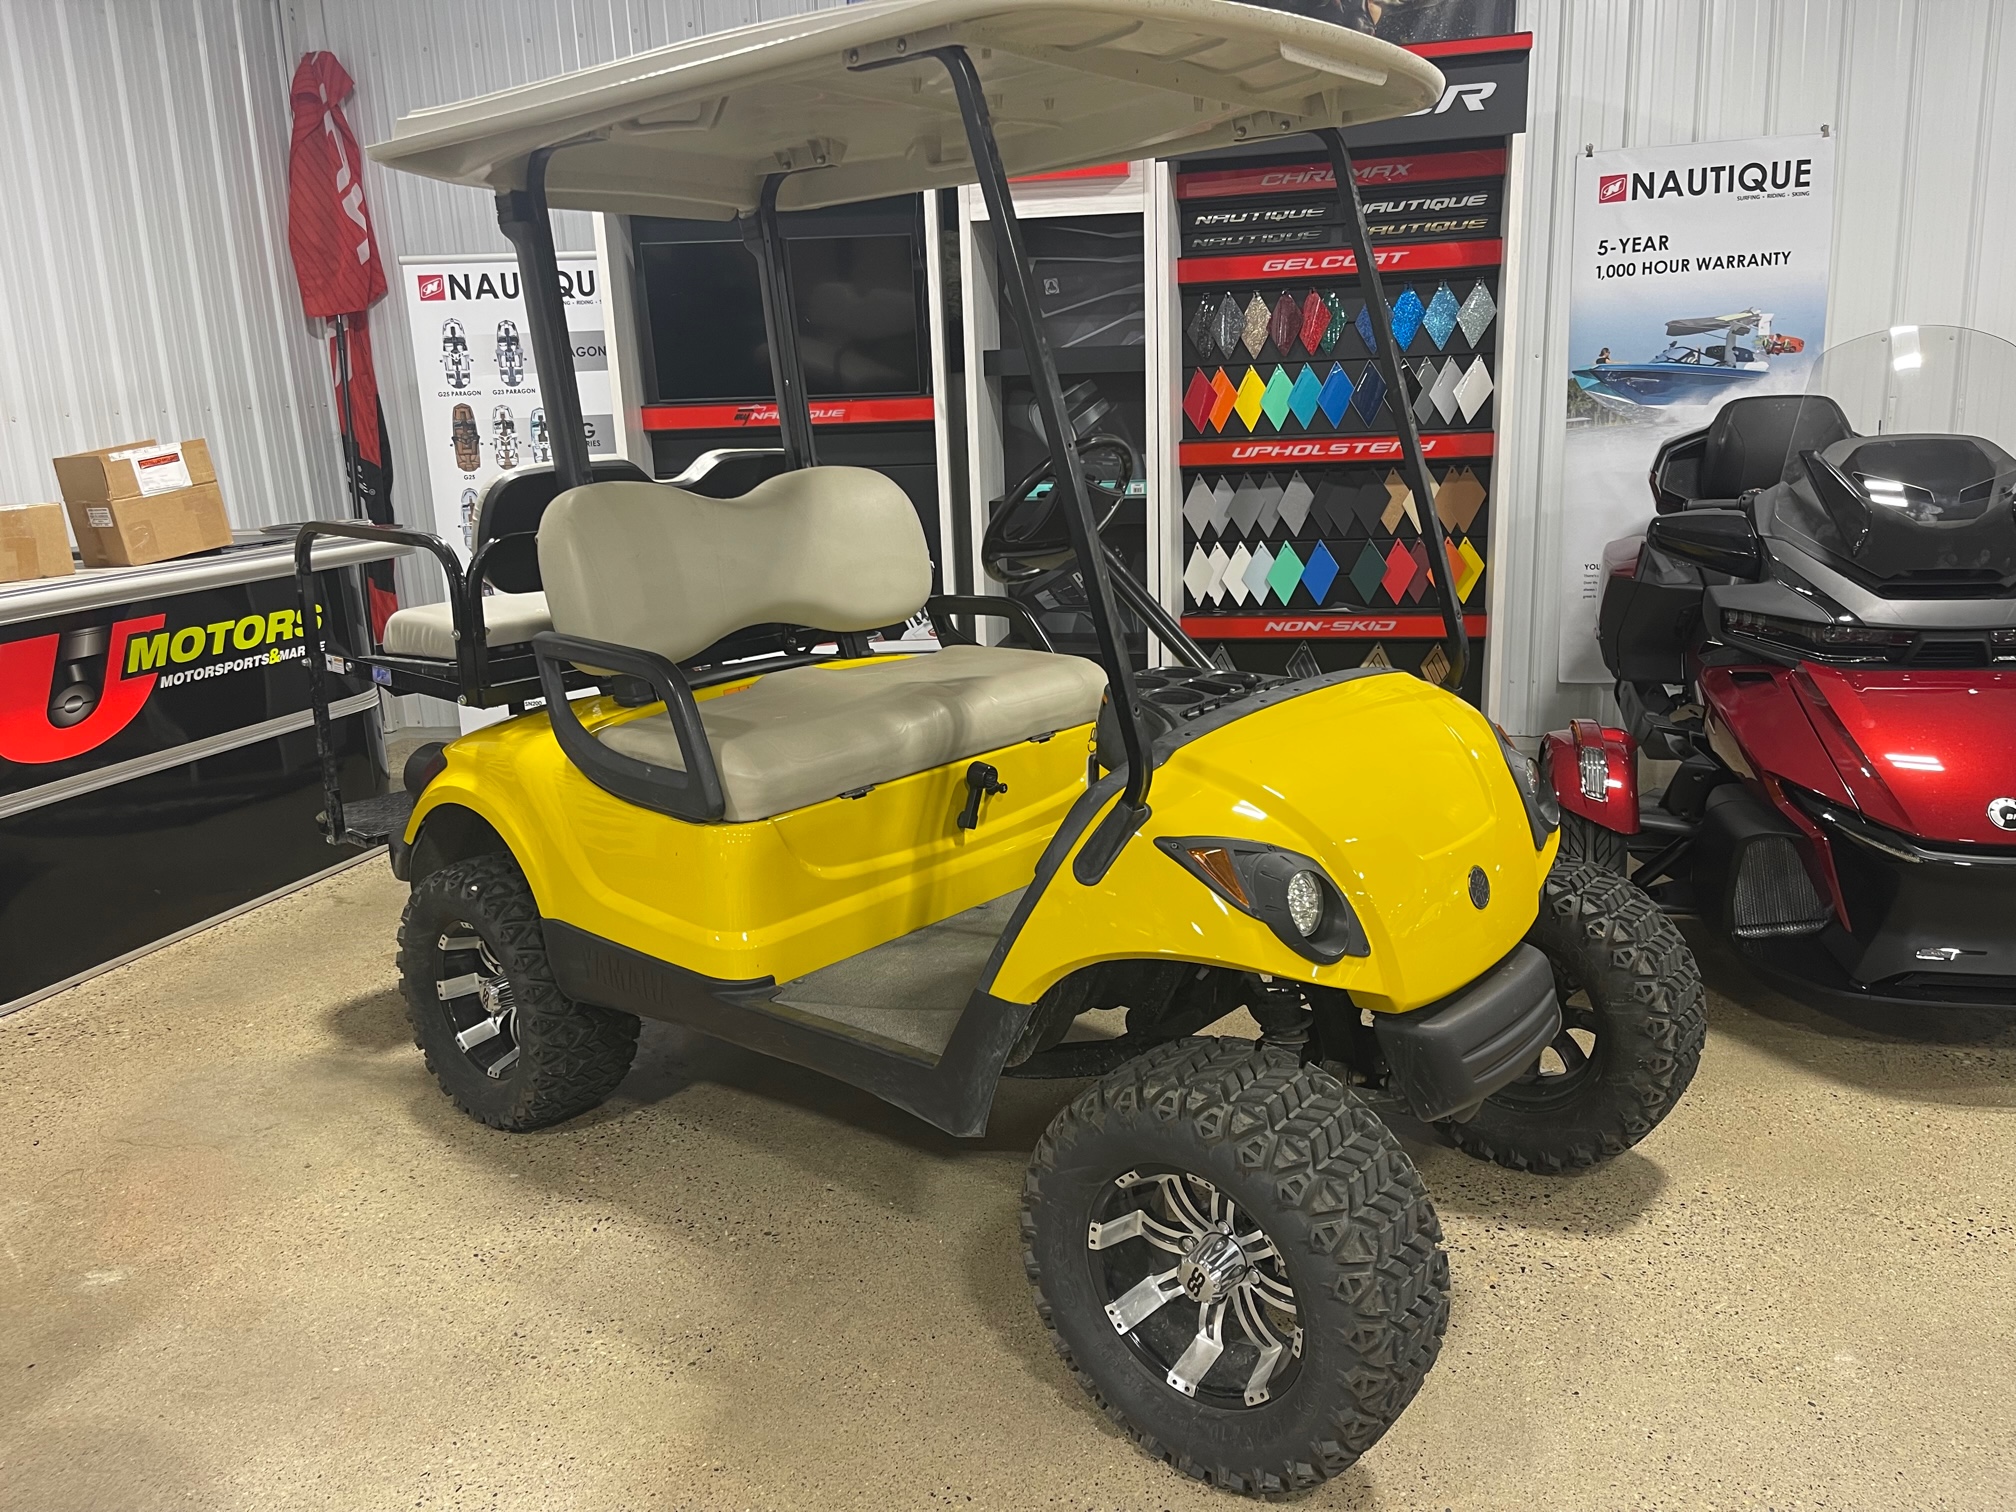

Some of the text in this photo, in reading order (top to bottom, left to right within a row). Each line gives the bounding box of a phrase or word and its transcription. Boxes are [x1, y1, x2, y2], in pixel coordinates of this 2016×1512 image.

[1632, 159, 1811, 200] NAUTIQUE
[1194, 207, 1327, 225] NAUTIQUE
[1366, 218, 1488, 236] AUTIQUE
[1191, 230, 1323, 248] NAUTIQUE
[1597, 235, 1669, 256] 5-YEAR
[1595, 251, 1792, 281] 1,000 HOUR WARRANTY
[448, 270, 596, 301] NAUQU
[1264, 620, 1396, 633] NON-SKID
